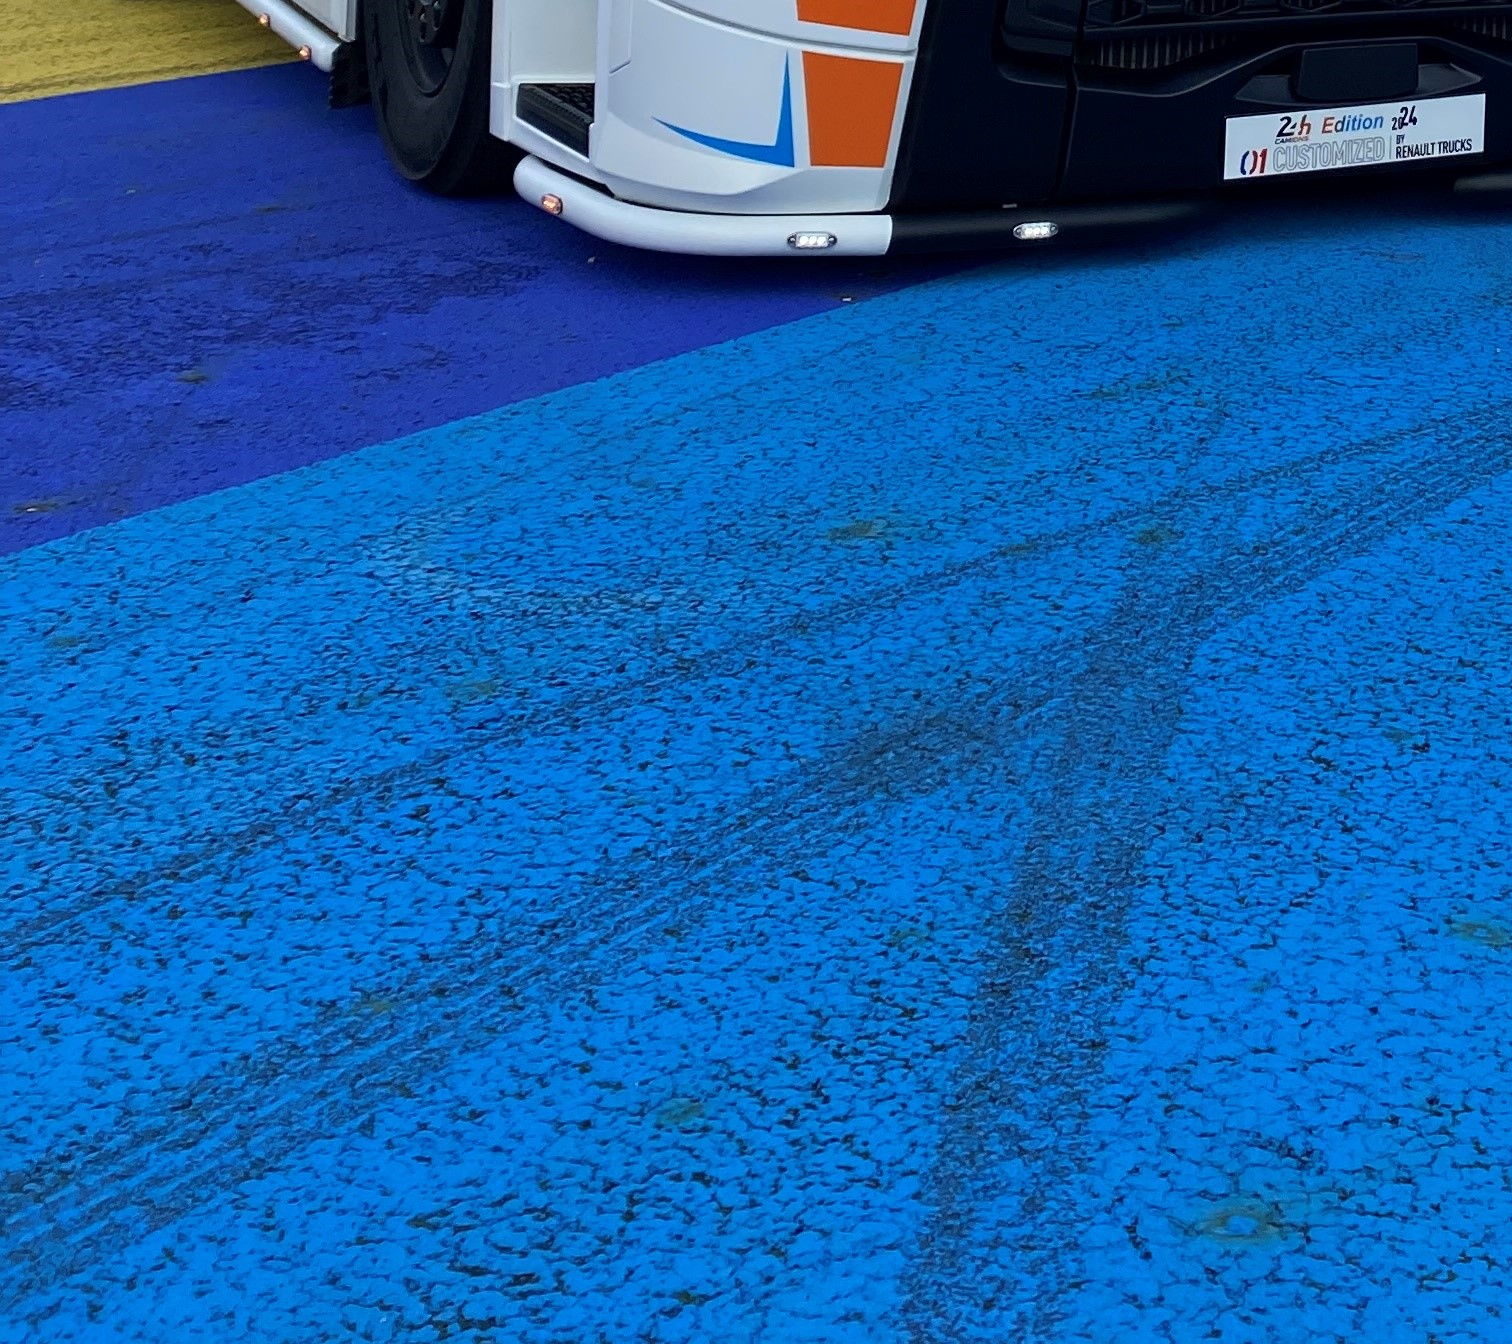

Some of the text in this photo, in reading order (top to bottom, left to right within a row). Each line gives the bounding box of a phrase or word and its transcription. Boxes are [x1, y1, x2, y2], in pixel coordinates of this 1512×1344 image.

[1321, 113, 1384, 135] Edition
[1274, 135, 1310, 145] CAMIONS
[1396, 133, 1406, 145] BY
[1240, 136, 1473, 176] 01 CUSTOMIZED RENAULT TRUCKS
